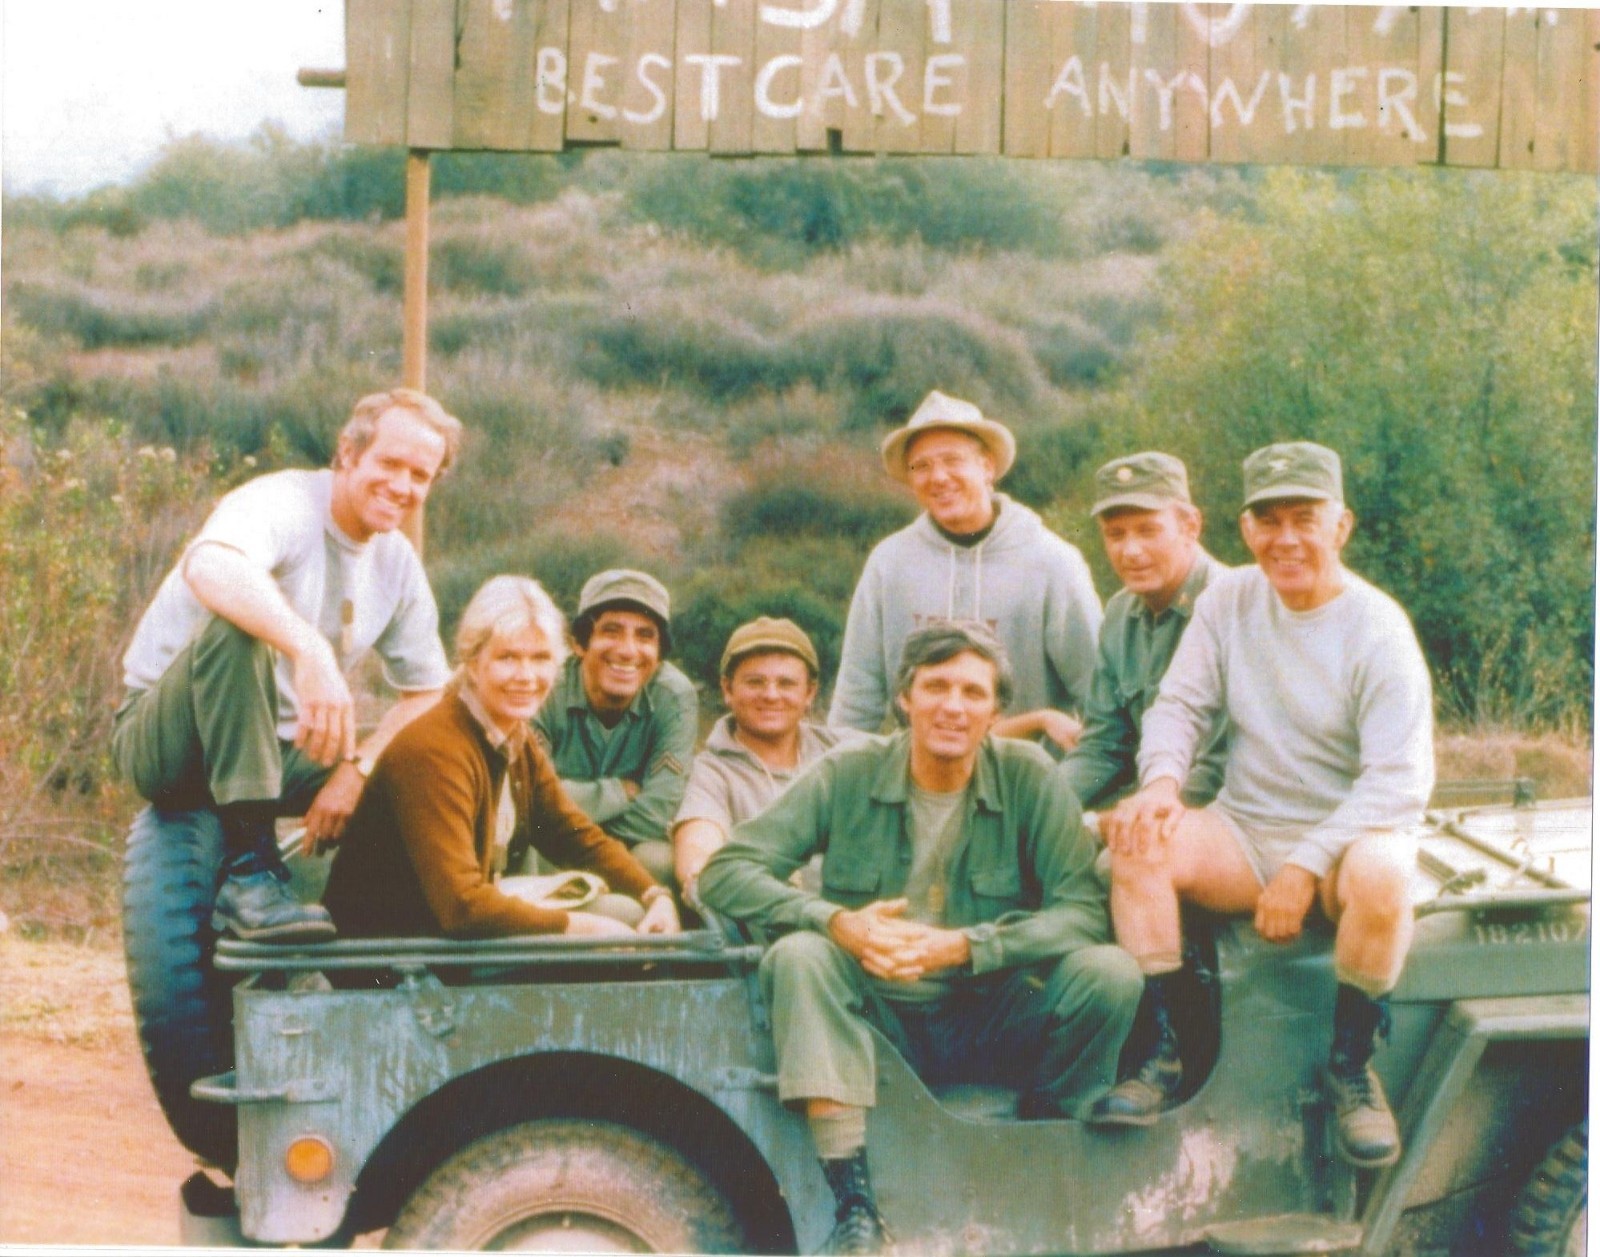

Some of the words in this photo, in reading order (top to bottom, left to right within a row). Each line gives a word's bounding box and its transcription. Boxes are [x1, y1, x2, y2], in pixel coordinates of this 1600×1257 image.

[535, 47, 742, 125] BEST
[753, 52, 966, 126] CARE
[1043, 54, 1484, 143] ANYWHERE
